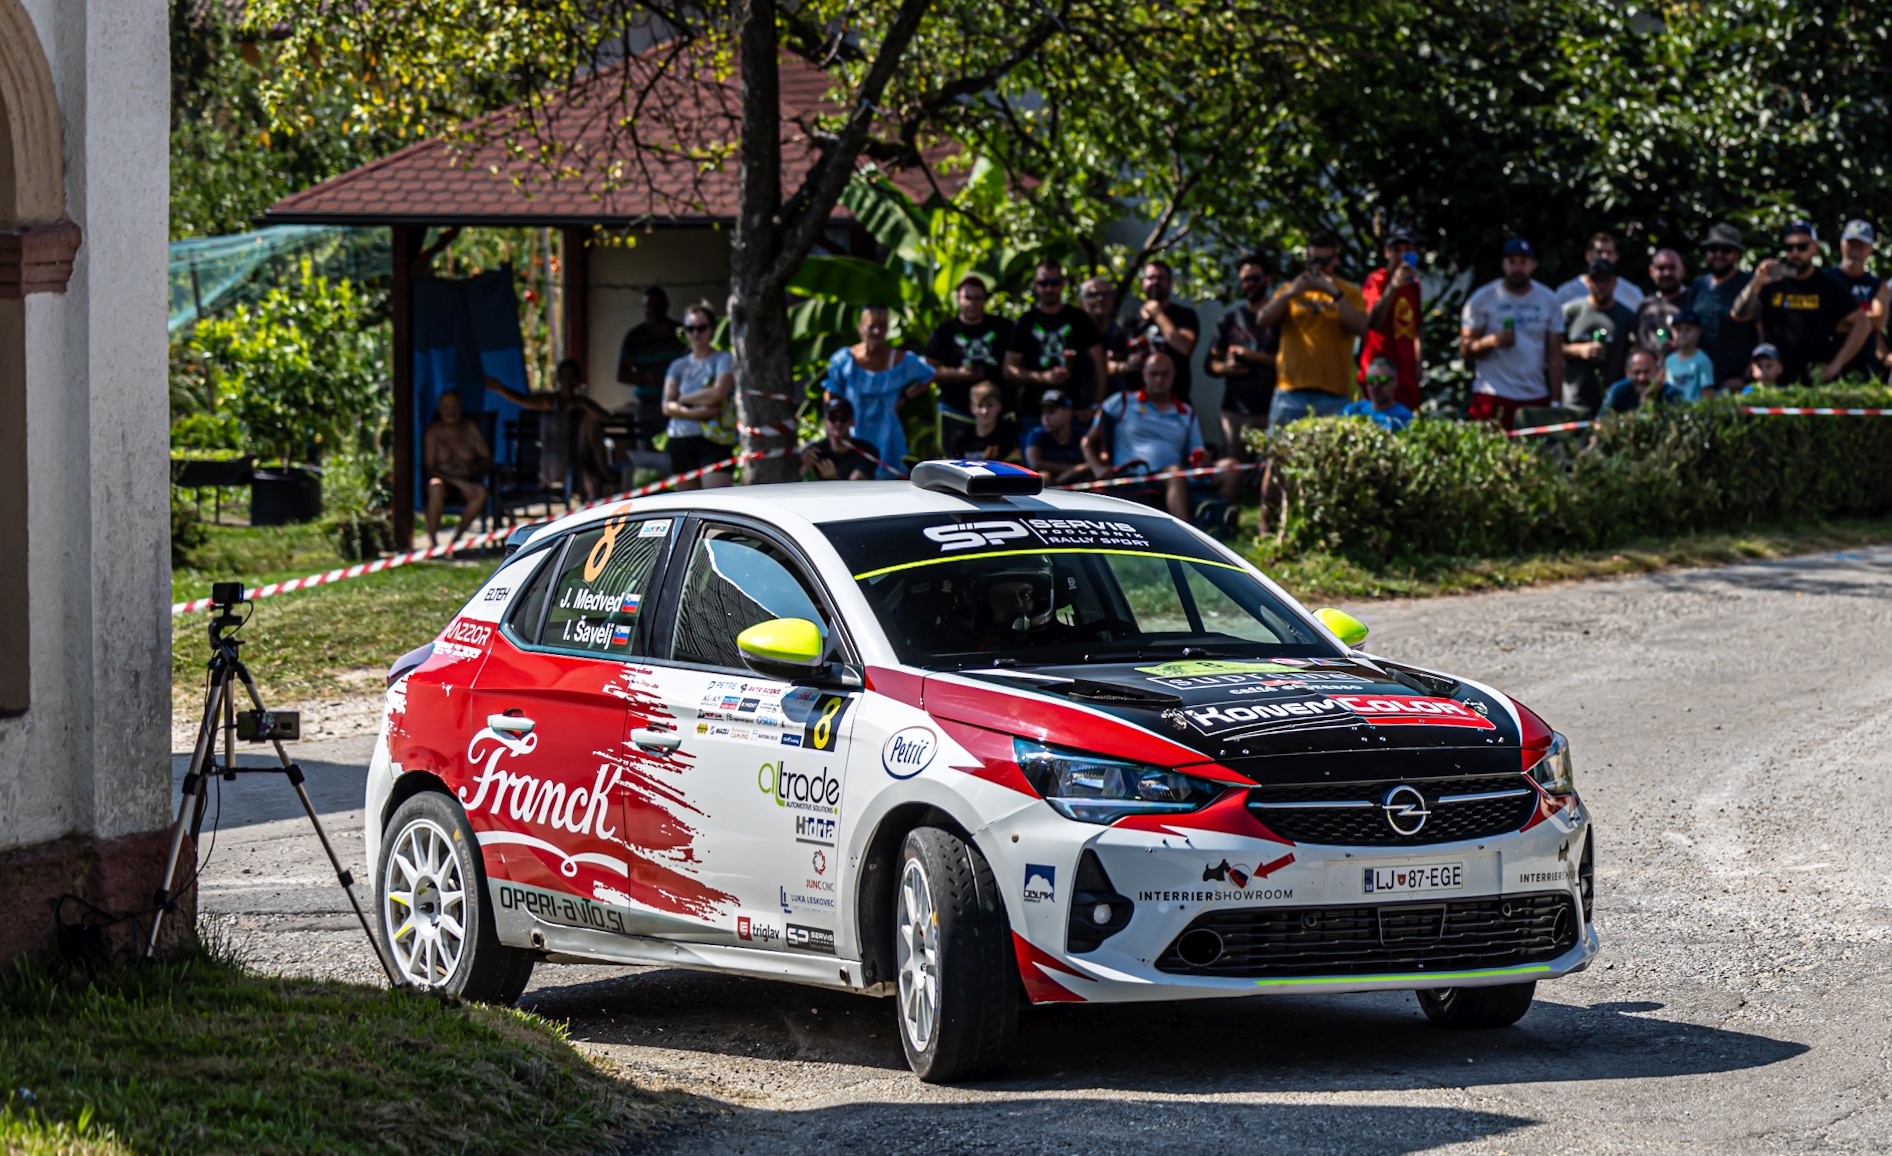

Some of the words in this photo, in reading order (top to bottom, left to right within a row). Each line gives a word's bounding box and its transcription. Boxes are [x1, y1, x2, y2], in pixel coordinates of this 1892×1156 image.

[1028, 519, 1137, 532] SERVIS
[583, 502, 633, 583] 8
[1048, 536, 1094, 544] RALLY
[1099, 537, 1150, 547] SPORT
[560, 587, 573, 608] J.
[573, 588, 626, 613] Medved
[562, 619, 572, 641] I.
[574, 614, 616, 650] Šavelj
[813, 697, 841, 750] 8
[458, 727, 623, 840] Franck
[757, 760, 840, 806] altrade
[786, 801, 811, 811] AUTOMOTIVE
[822, 881, 834, 892] CNC
[1376, 870, 1395, 890] LJ
[1408, 866, 1462, 888] 87-EGE
[791, 894, 806, 903] LUKA
[806, 896, 835, 907] LESKOVEC
[752, 923, 780, 942] triglav
